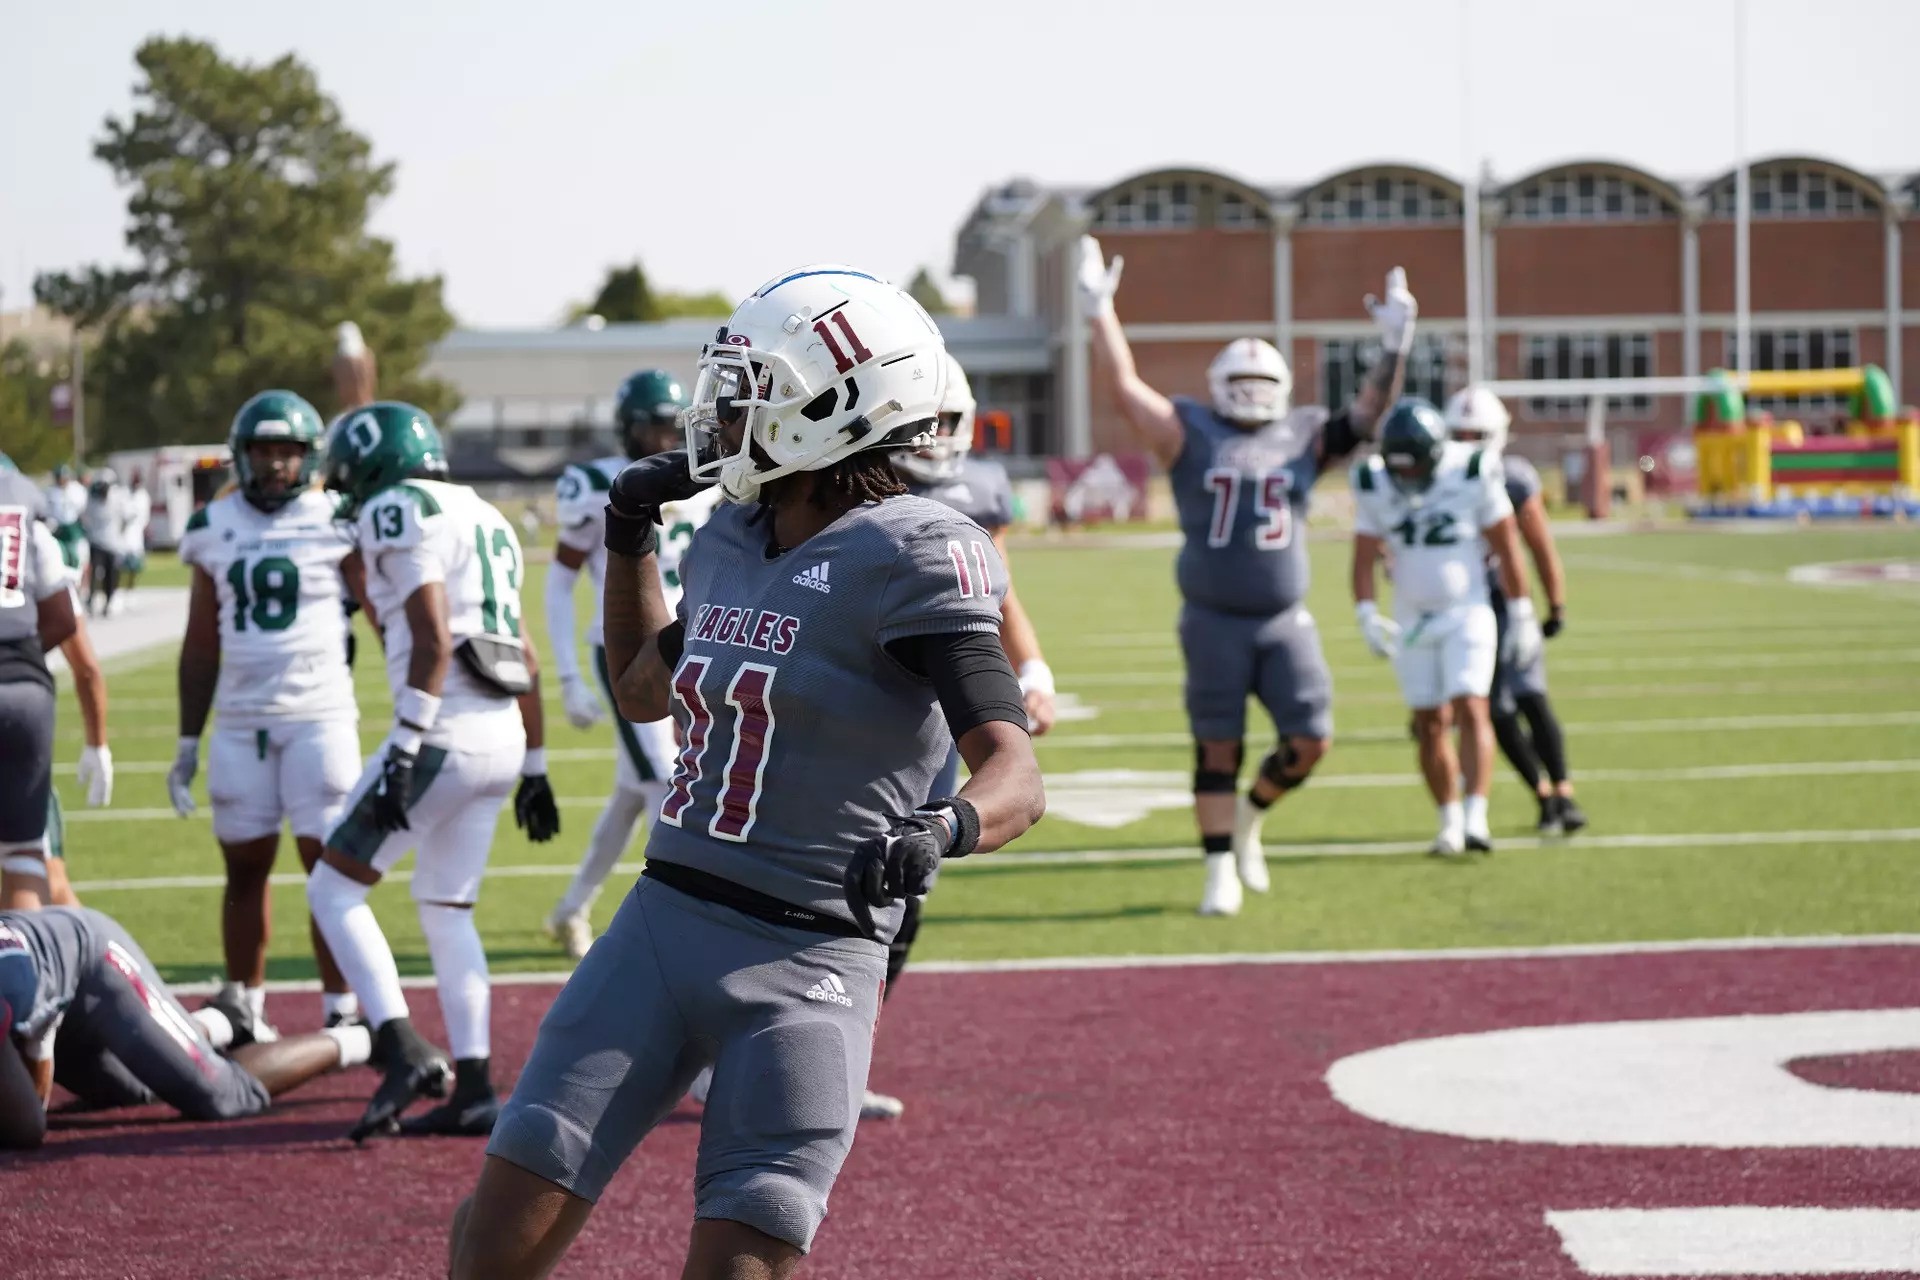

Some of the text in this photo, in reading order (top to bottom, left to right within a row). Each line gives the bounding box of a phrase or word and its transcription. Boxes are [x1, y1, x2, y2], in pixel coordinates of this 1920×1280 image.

[812, 310, 874, 376] 11
[346, 412, 383, 458] D
[371, 504, 403, 542] 13
[1203, 467, 1295, 551] 75
[226, 555, 299, 634] 18
[474, 523, 521, 638] 13
[792, 573, 831, 594] adidas
[947, 540, 991, 599] 11
[659, 654, 778, 843] 11
[806, 989, 853, 1009] adidas
